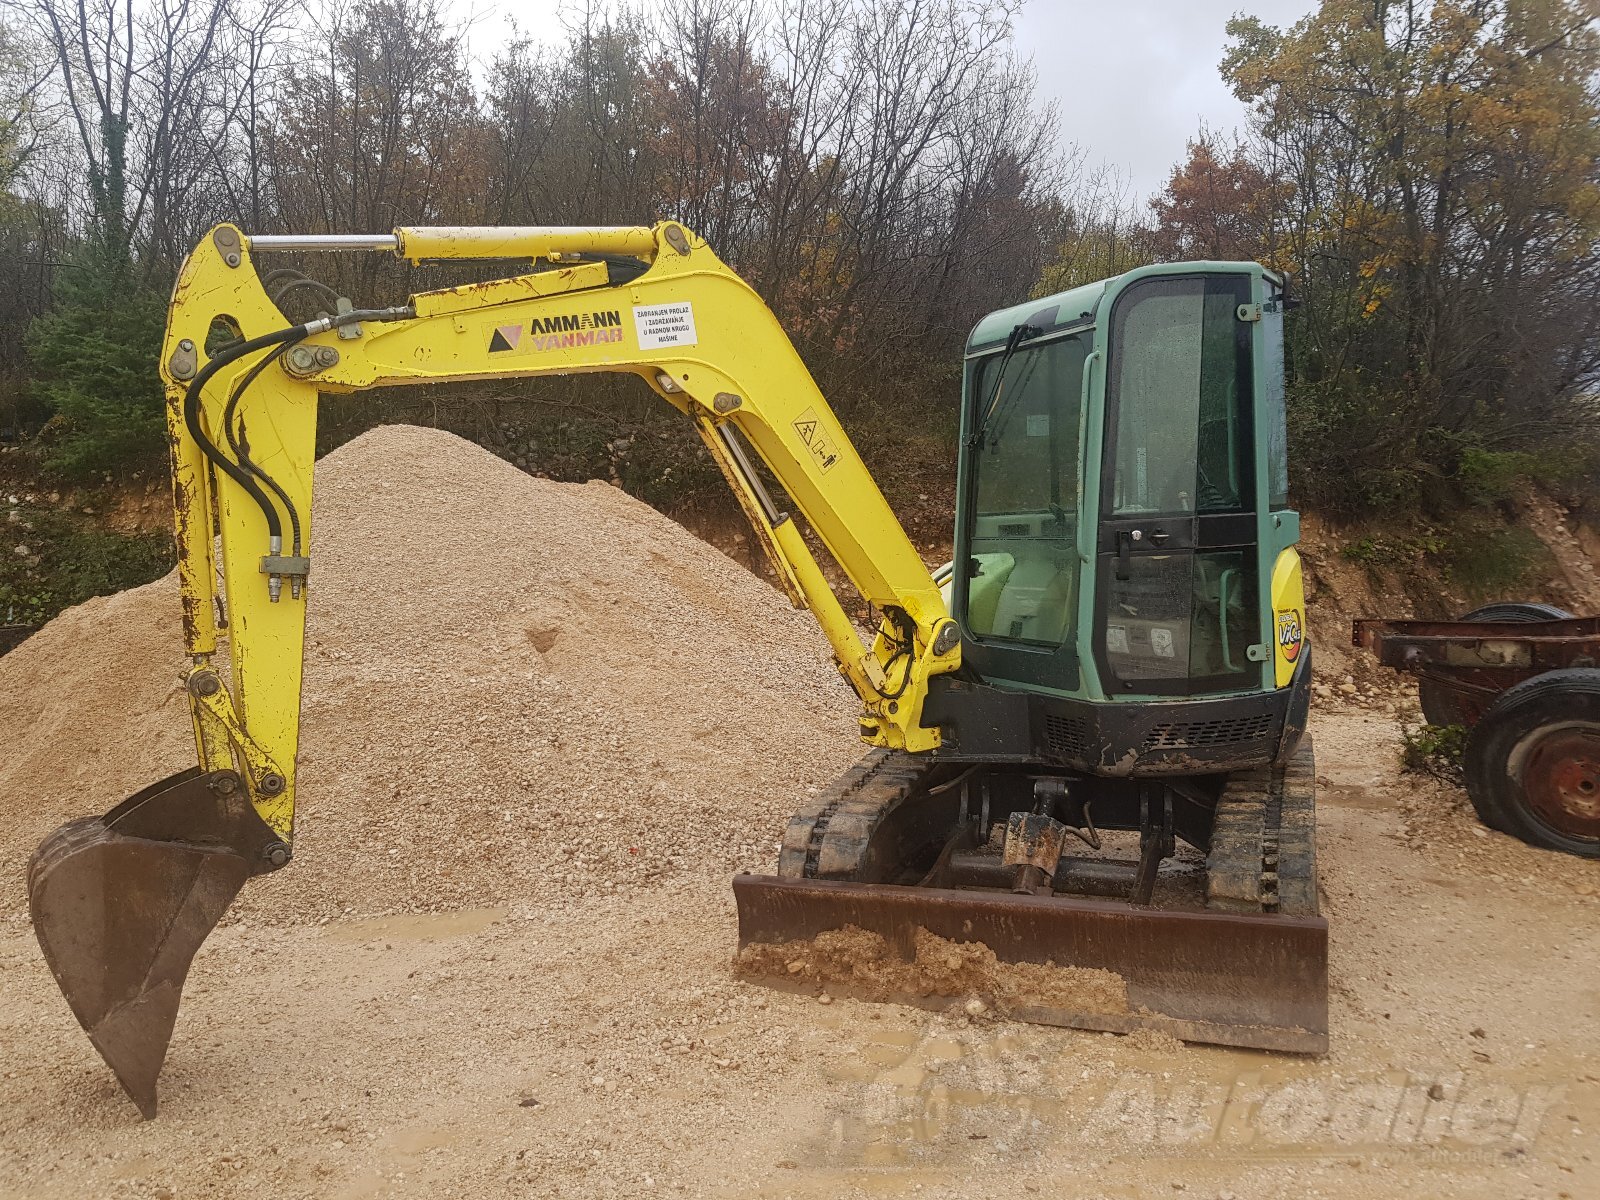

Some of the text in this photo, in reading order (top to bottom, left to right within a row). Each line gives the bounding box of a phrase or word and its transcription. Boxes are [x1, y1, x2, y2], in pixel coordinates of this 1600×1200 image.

[668, 306, 689, 315] PROLAZ
[531, 311, 622, 335] AMMANN
[532, 328, 623, 351] YANMAR
